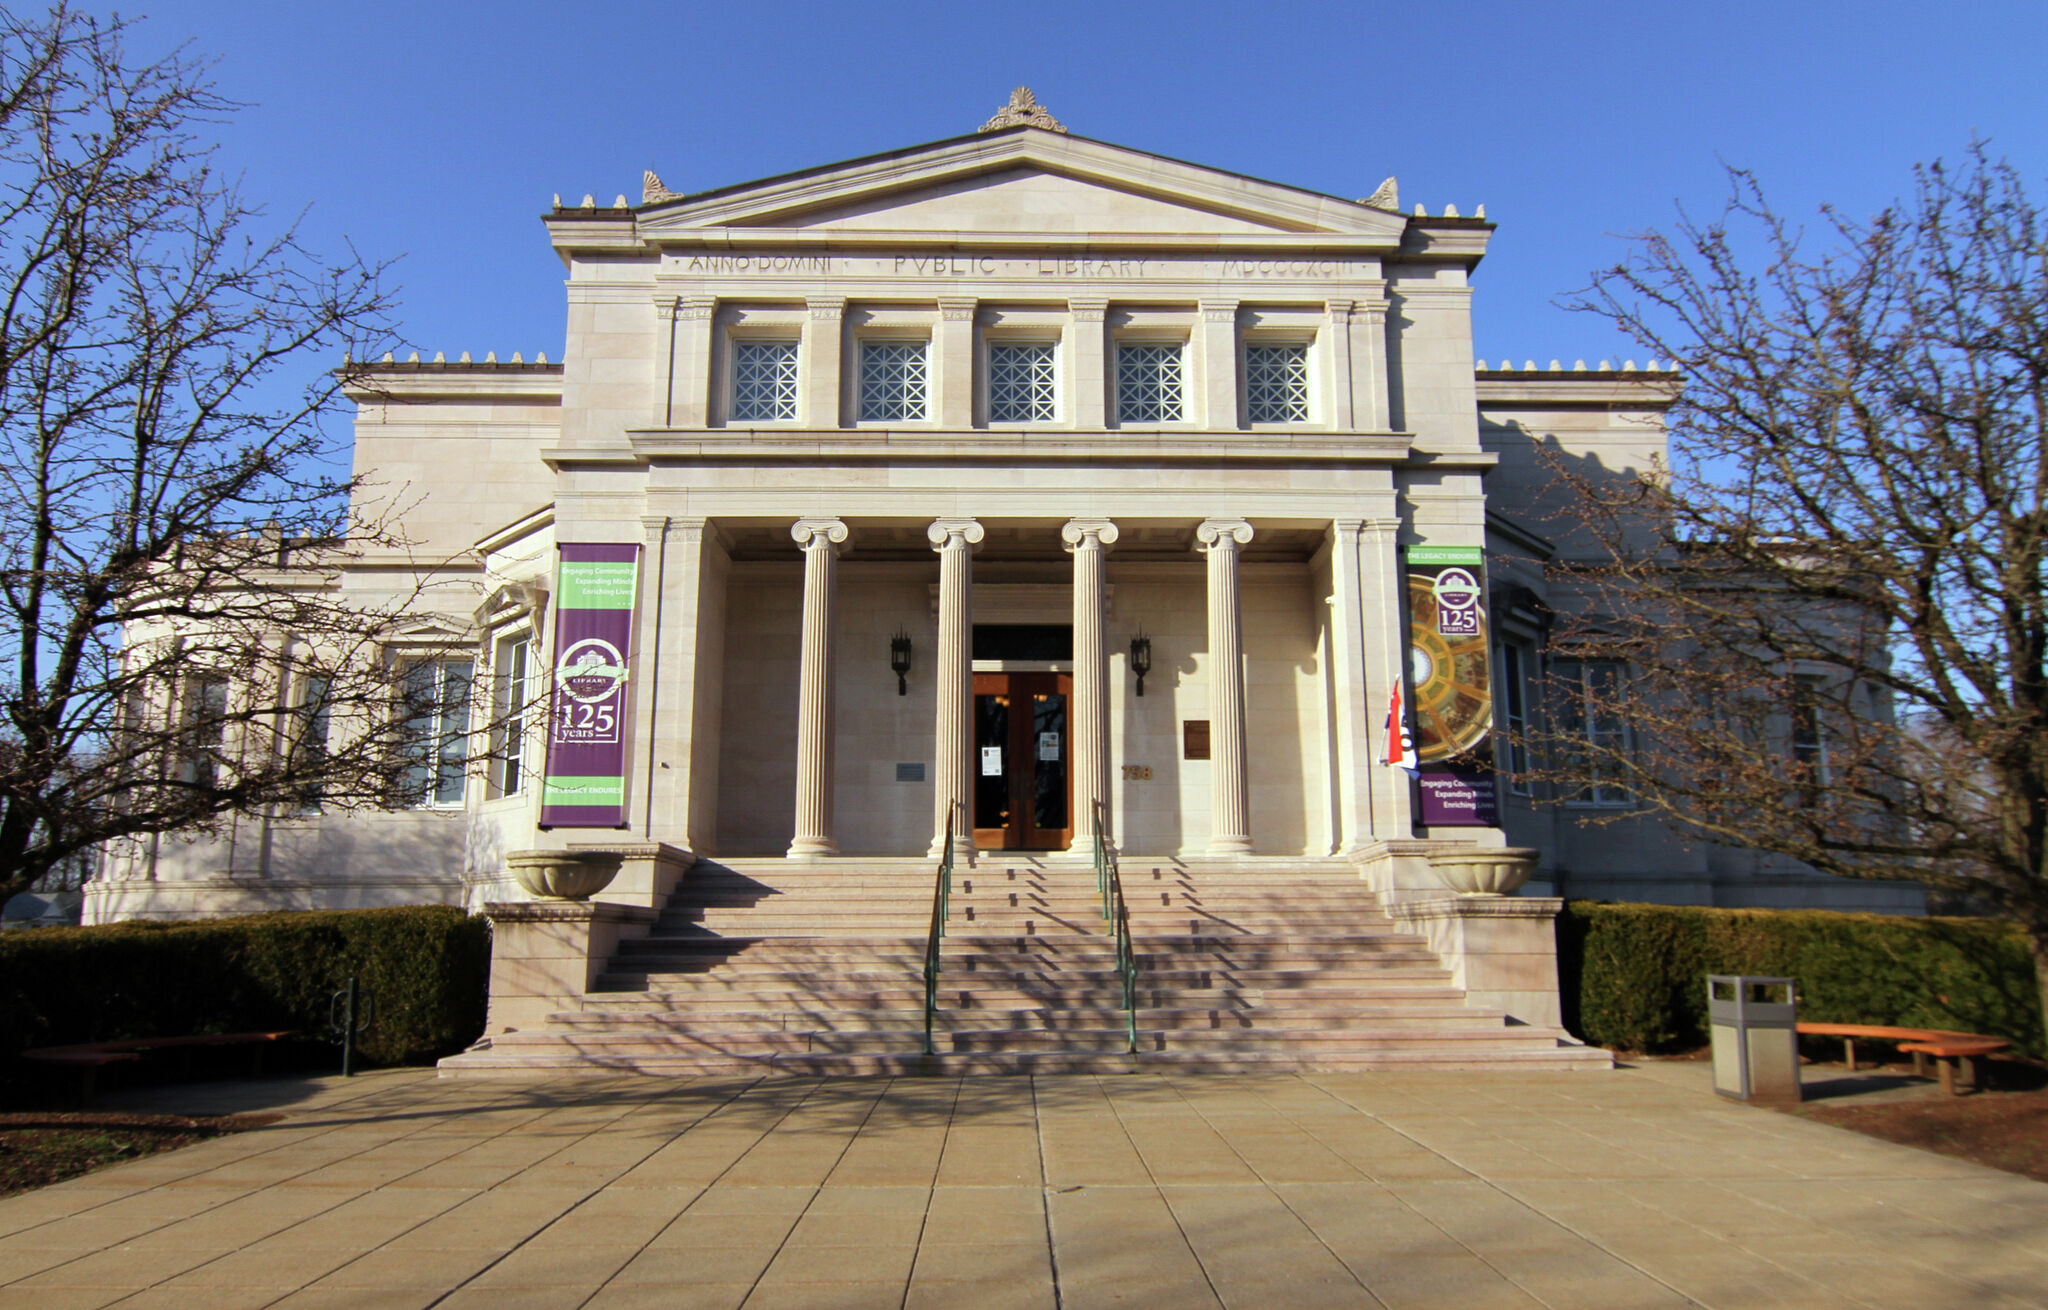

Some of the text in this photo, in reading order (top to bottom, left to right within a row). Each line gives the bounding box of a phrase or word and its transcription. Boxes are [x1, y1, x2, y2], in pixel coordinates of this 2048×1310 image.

[689, 255, 831, 273] ANNO DOMINI
[893, 255, 1149, 276] PVBLIC LIBRARY
[1440, 610, 1476, 629] 125
[1442, 626, 1464, 634] years
[561, 703, 615, 733] 125
[562, 729, 594, 741] years
[1121, 765, 1153, 781] 758
[1420, 779, 1453, 789] Engaging
[1434, 790, 1472, 800] Expanding
[1443, 801, 1477, 811] Enriching
